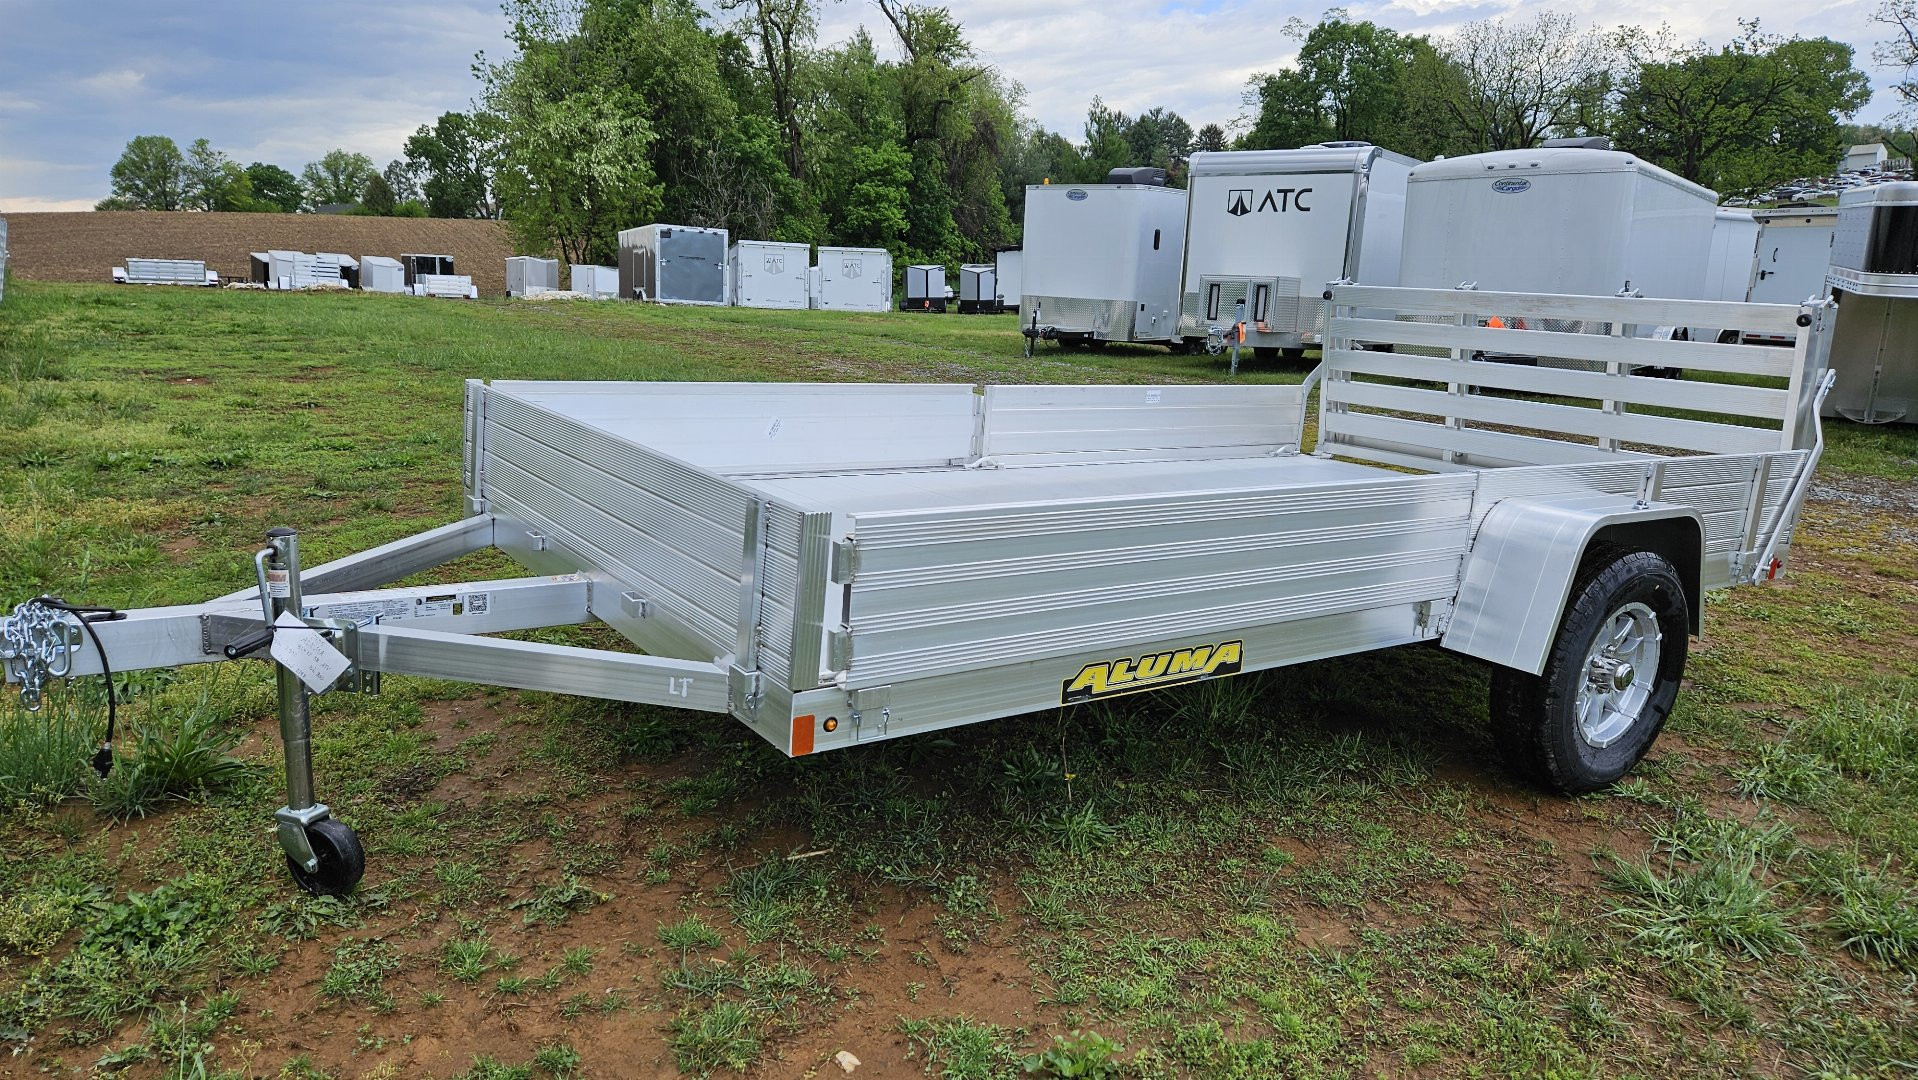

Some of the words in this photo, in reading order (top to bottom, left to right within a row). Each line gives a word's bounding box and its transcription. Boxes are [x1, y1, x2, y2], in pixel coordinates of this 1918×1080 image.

[1257, 188, 1312, 212] ATC
[1066, 642, 1242, 694] ALUMA
[669, 676, 694, 698] LT
